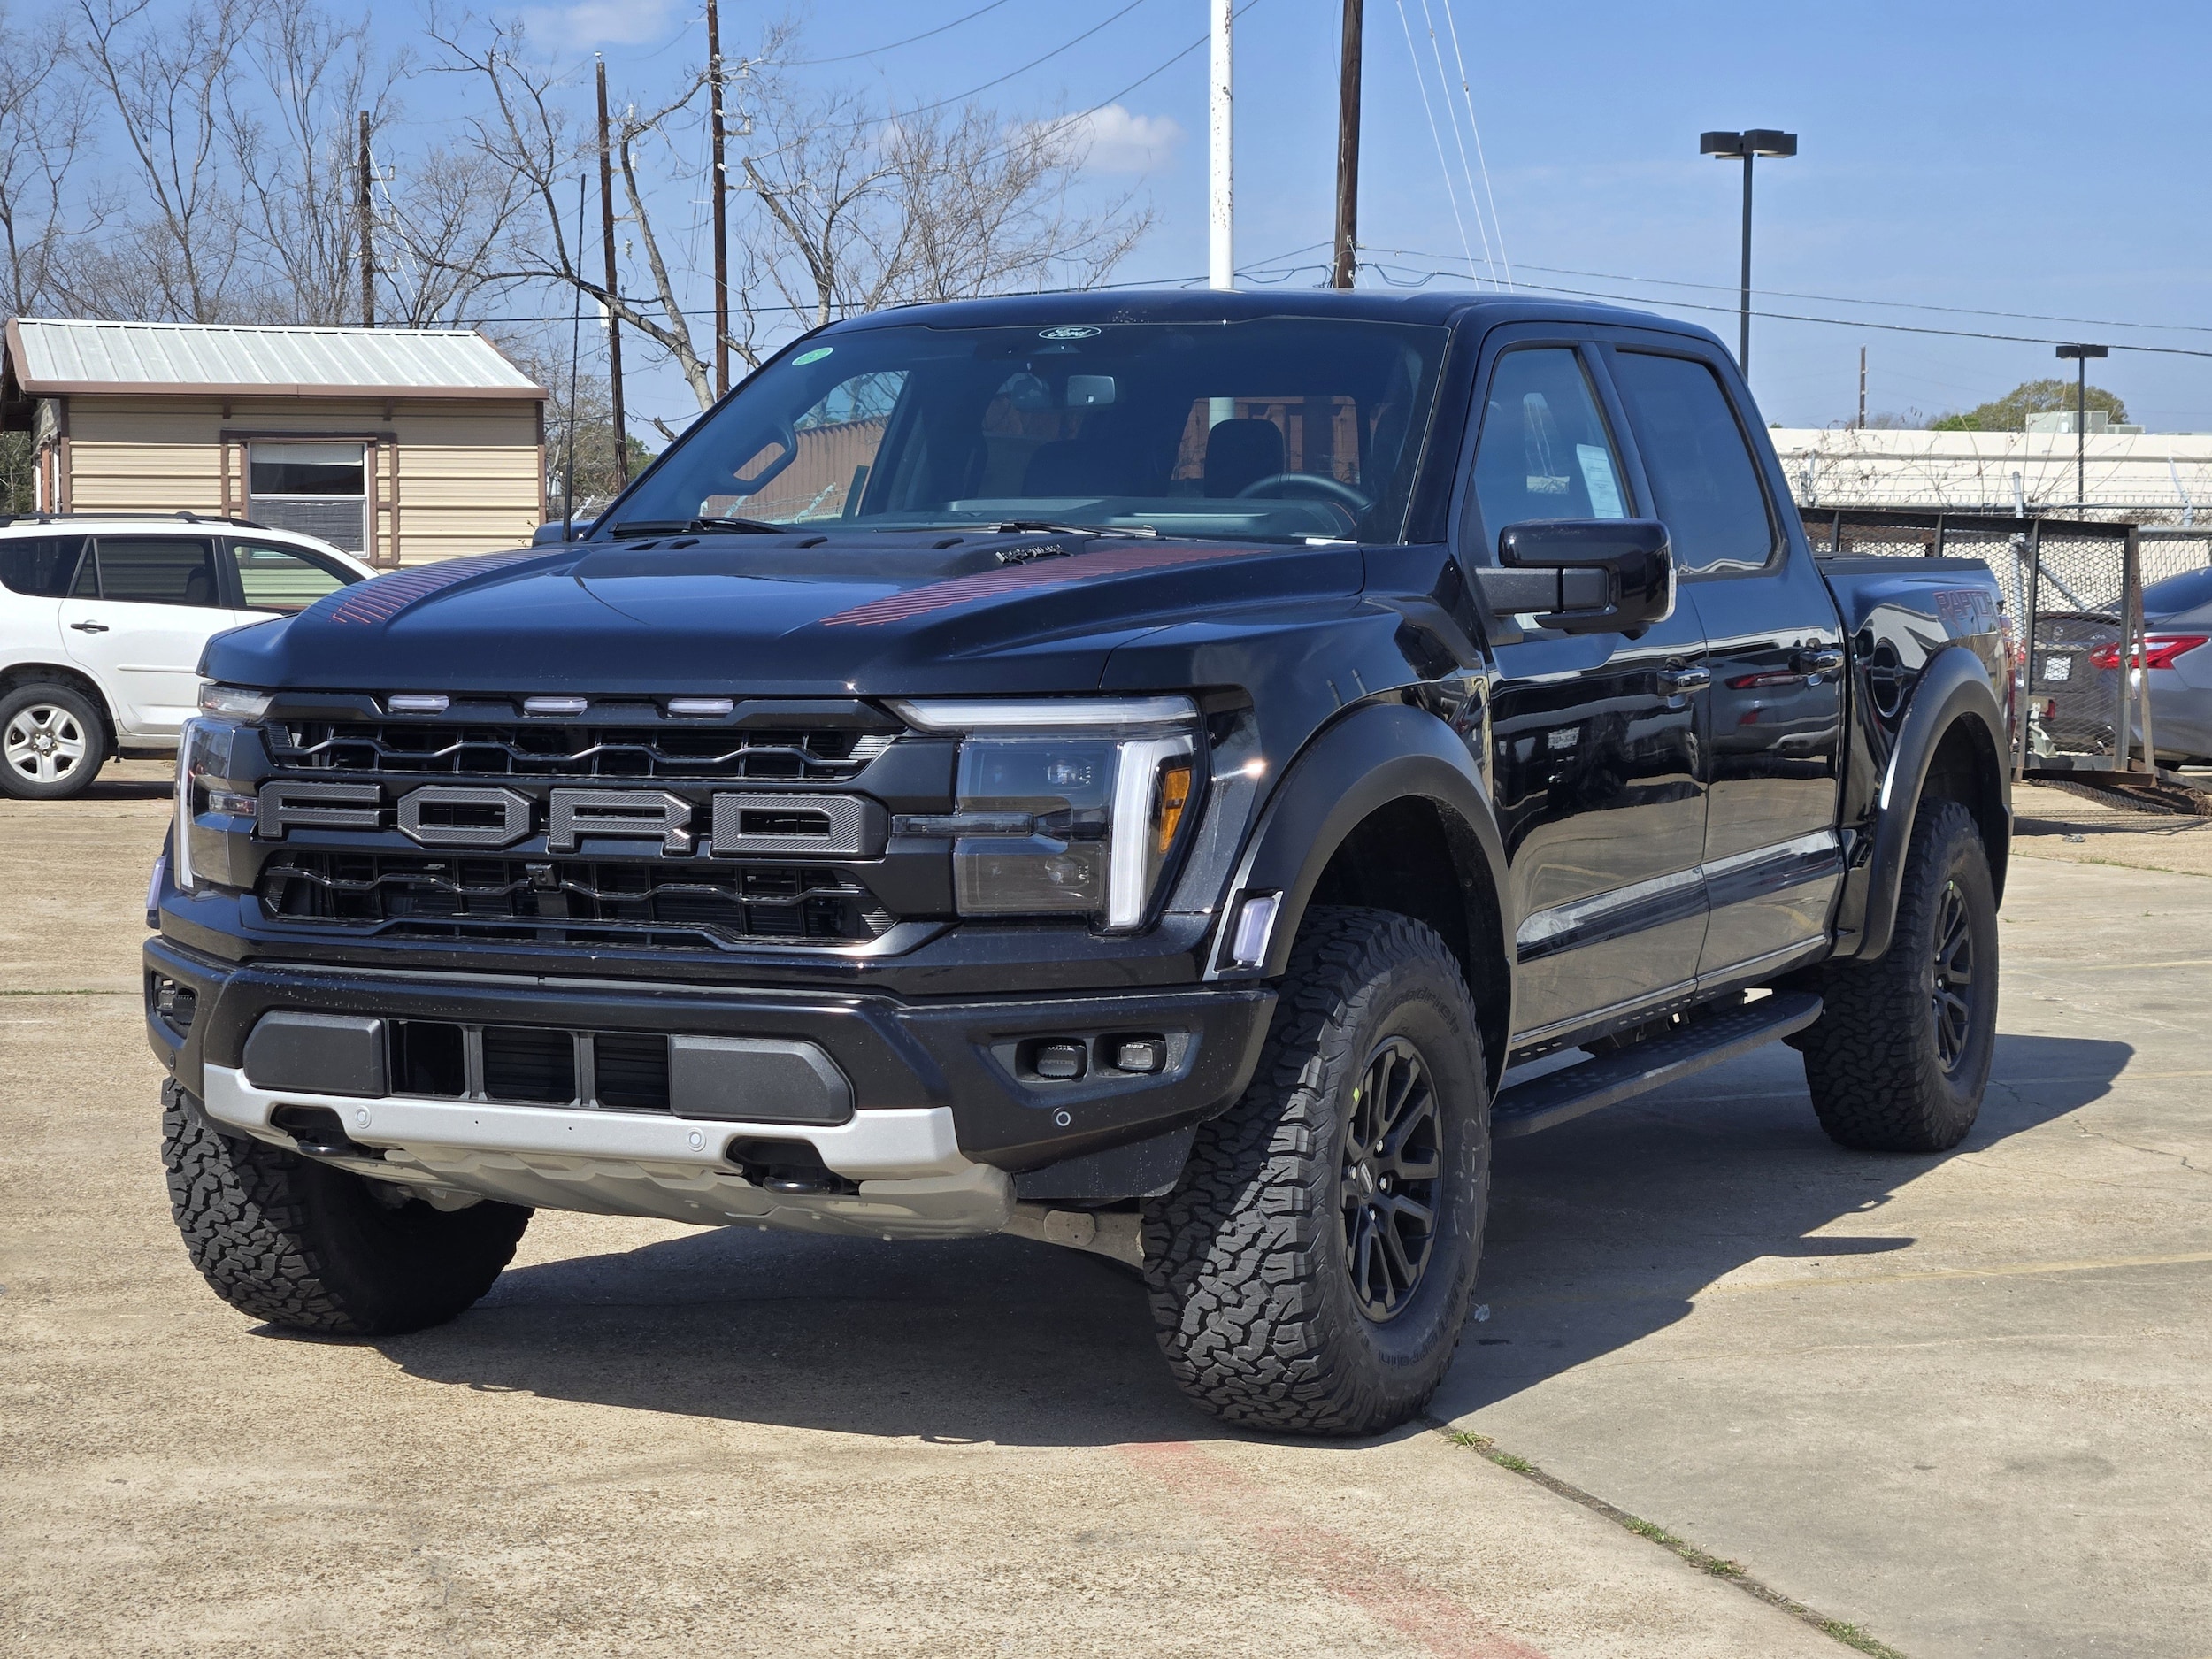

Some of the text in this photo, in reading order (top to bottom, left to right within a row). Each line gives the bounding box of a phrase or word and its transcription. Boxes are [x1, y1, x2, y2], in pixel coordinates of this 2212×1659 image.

[1046, 326, 1093, 338] Ford
[1932, 589, 1994, 629] RAPTOR
[257, 780, 885, 858] FORD
